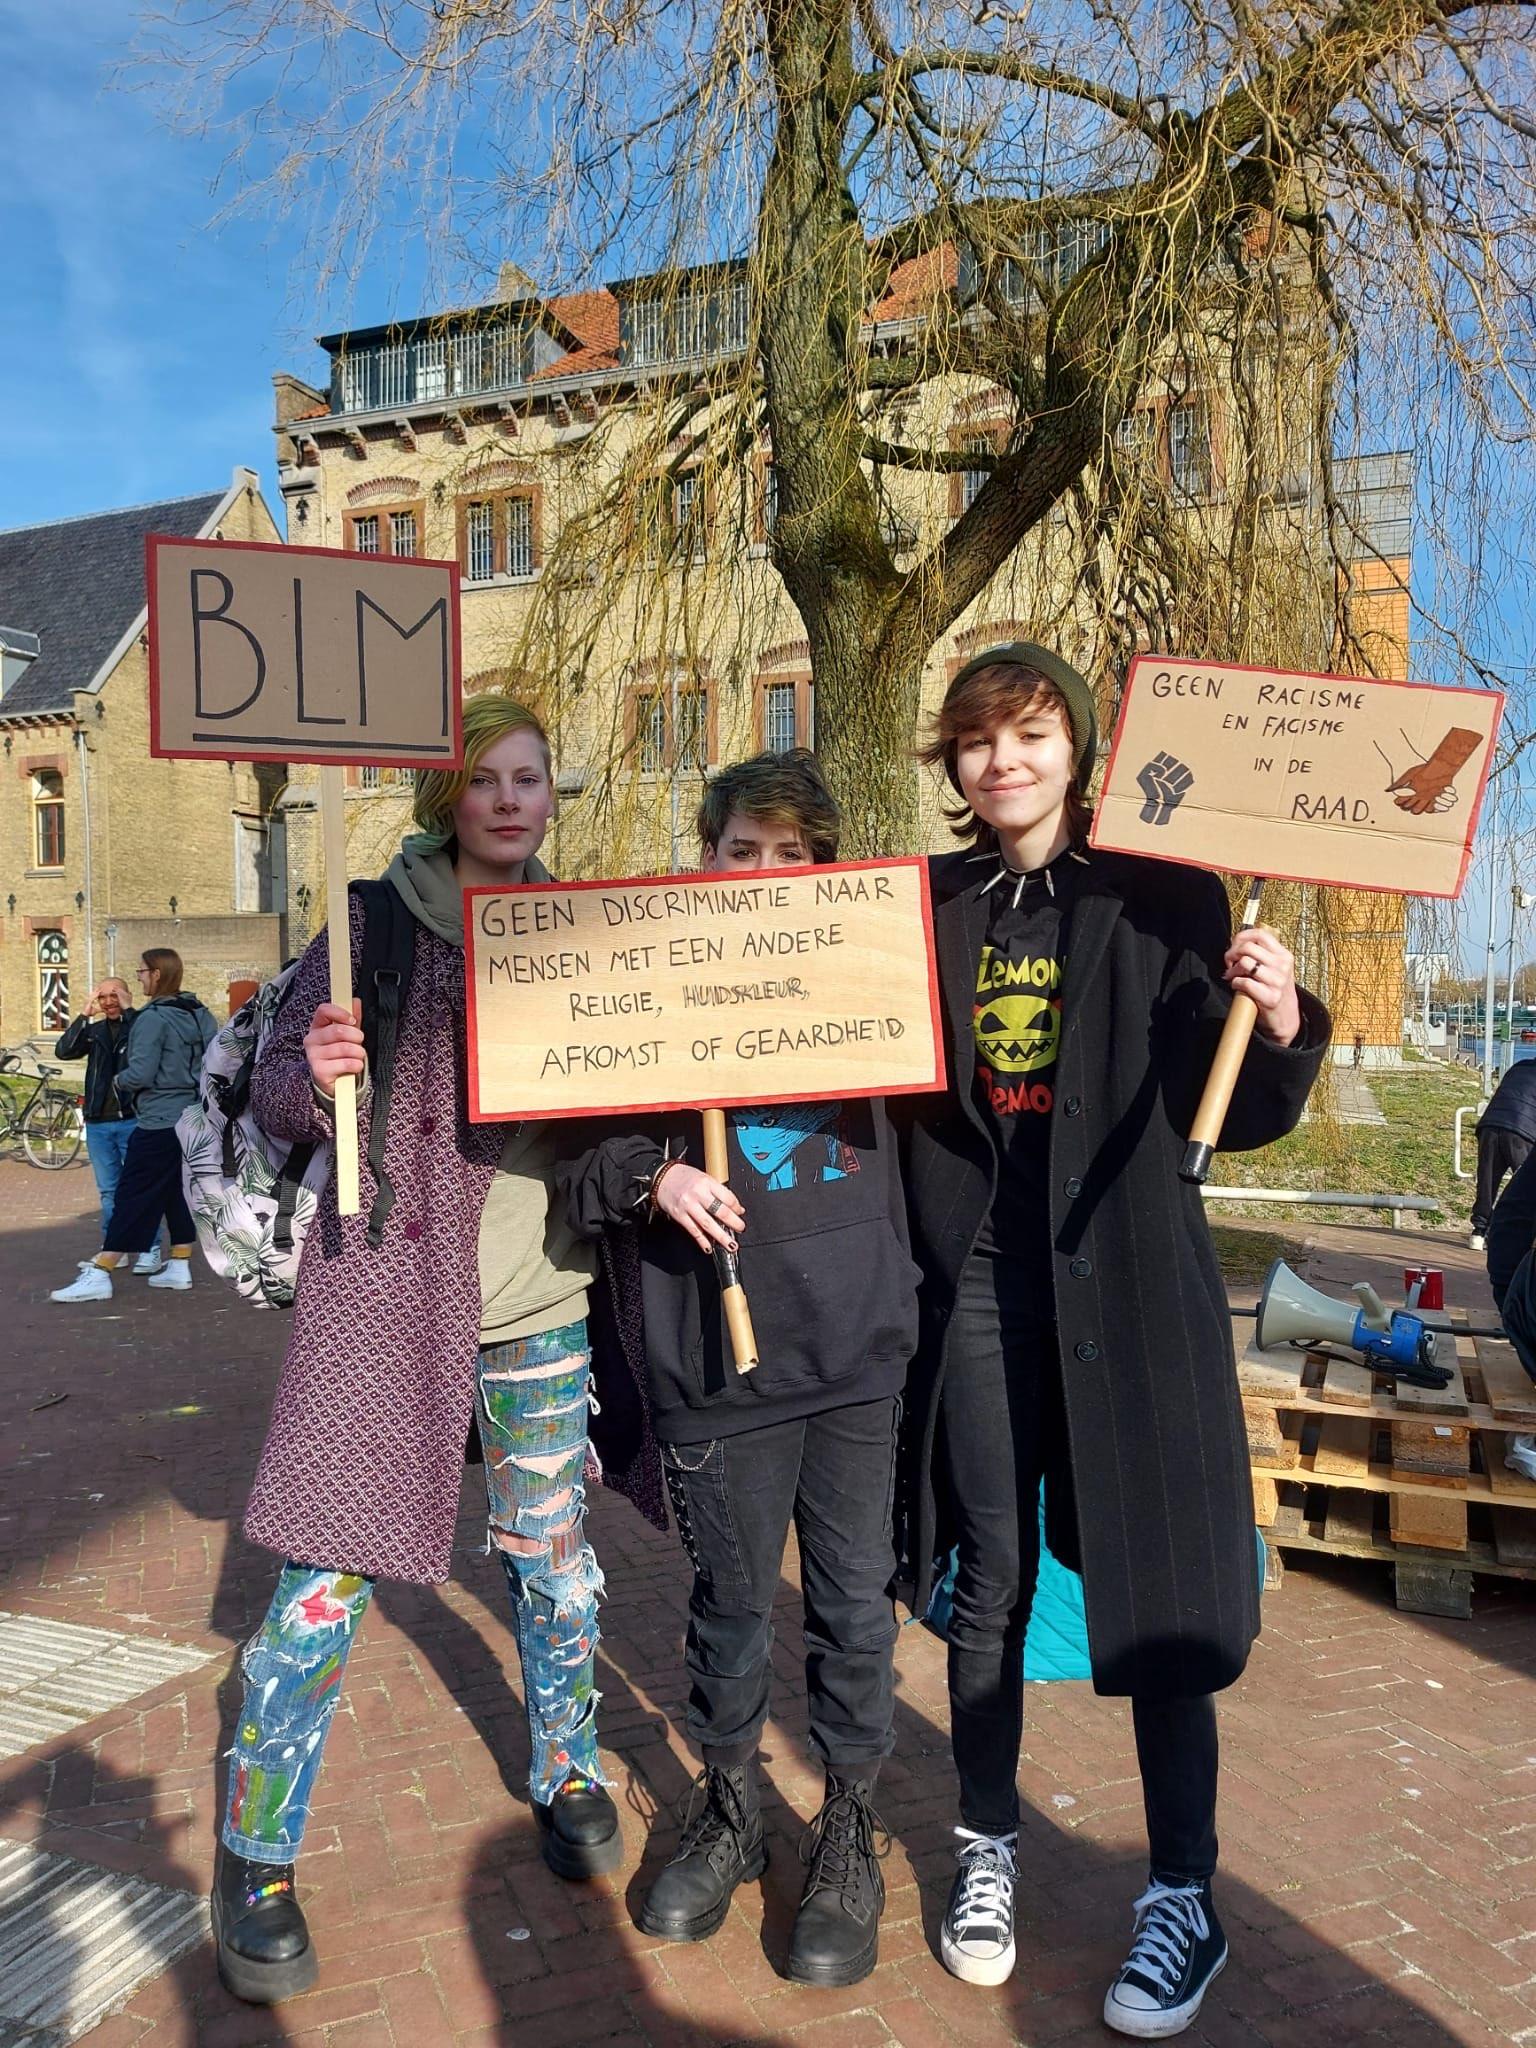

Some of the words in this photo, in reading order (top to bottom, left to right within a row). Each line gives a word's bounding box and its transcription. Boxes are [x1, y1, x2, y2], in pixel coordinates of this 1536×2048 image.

[190, 568, 450, 737] BLM
[1152, 671, 1224, 700] GEEN
[1257, 684, 1366, 710] RACISME
[1222, 713, 1249, 730] EN
[1262, 716, 1345, 737] FACISME
[1254, 757, 1273, 774] IN
[1287, 758, 1312, 774] DE
[1291, 793, 1376, 825] RAAD.
[480, 898, 575, 938] GEEN
[602, 886, 790, 926] DISCRIMINATIE
[815, 876, 895, 906] NAAR
[489, 951, 590, 984] MENSEN
[609, 945, 657, 973] MET
[669, 936, 725, 967] EEN
[742, 923, 845, 959] ANDERE
[569, 991, 663, 1022] RELIGIE,
[541, 1041, 666, 1078] AFKOMST
[692, 1036, 724, 1062] OF
[735, 1017, 905, 1059] GEAARDHEID
